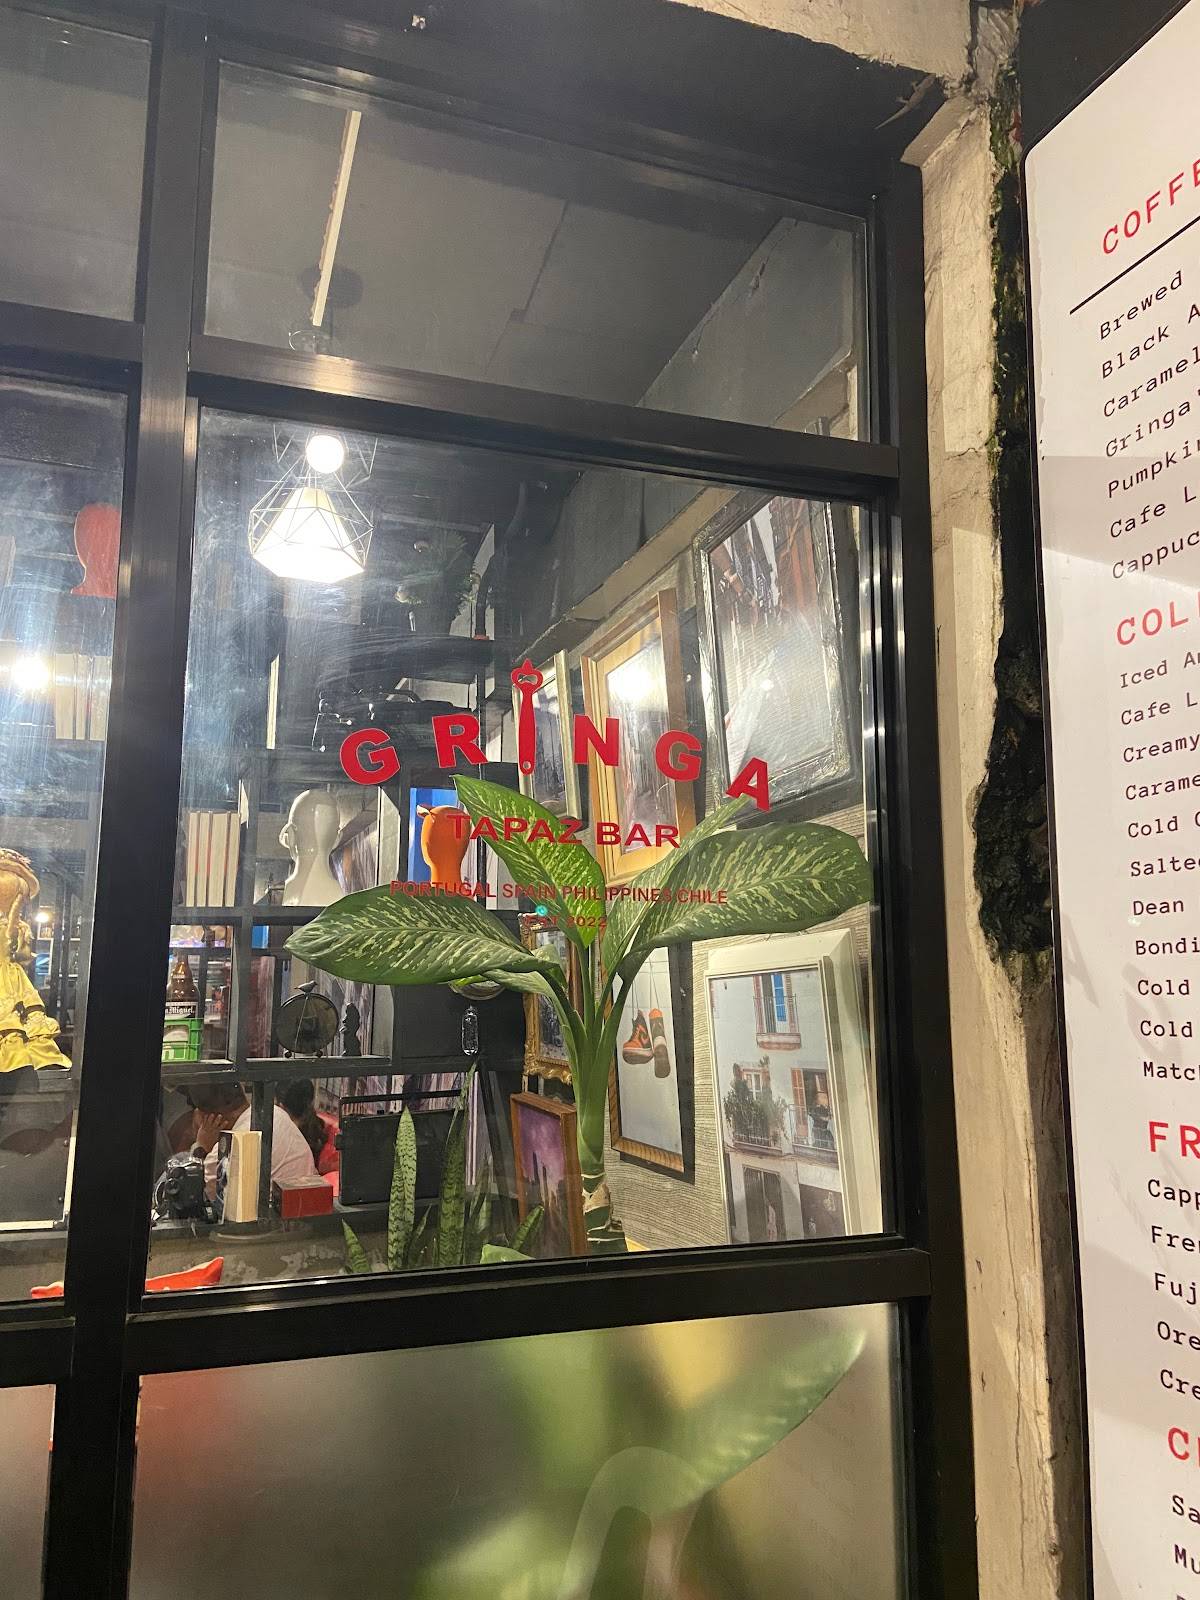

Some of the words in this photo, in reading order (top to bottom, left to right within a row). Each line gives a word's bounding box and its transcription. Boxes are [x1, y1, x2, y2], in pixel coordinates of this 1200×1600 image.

[1100, 270, 1183, 340] Brewed
[1101, 325, 1169, 379] Black
[1103, 346, 1200, 418] Caramel
[1106, 401, 1190, 457] Gringa
[1108, 439, 1200, 498] Pumpki
[1110, 503, 1166, 538] Cafe
[1112, 531, 1200, 579] Cappuc
[1116, 591, 1200, 646] COL
[1120, 660, 1168, 689] Iced
[1184, 651, 1200, 668] A
[1121, 701, 1171, 726] Cafe
[340, 658, 772, 812] GRINGA
[1123, 734, 1200, 763] Creamy
[1125, 774, 1200, 800] Carame
[446, 814, 583, 845] TAPAZ
[596, 822, 681, 849] BAR
[1128, 816, 1178, 838] Cold
[1130, 856, 1200, 877] Salte
[389, 880, 496, 898] PORTUGAL
[502, 882, 556, 900] SPAIN
[562, 885, 671, 902] PHILIPPINES
[677, 888, 727, 904] CHILE
[1133, 900, 1184, 916] Dean
[566, 916, 607, 928] 2022
[1135, 937, 1200, 956] Bondi
[1137, 979, 1190, 996] Cold
[1140, 1020, 1193, 1038] Cold
[1143, 1061, 1200, 1081] Matc
[1149, 1121, 1200, 1160] FR
[1151, 1225, 1200, 1252] Fre
[1154, 1272, 1197, 1306] Fuj
[1157, 1321, 1200, 1351] Ore
[1160, 1369, 1200, 1401] Cre
[1168, 1427, 1200, 1468] C
